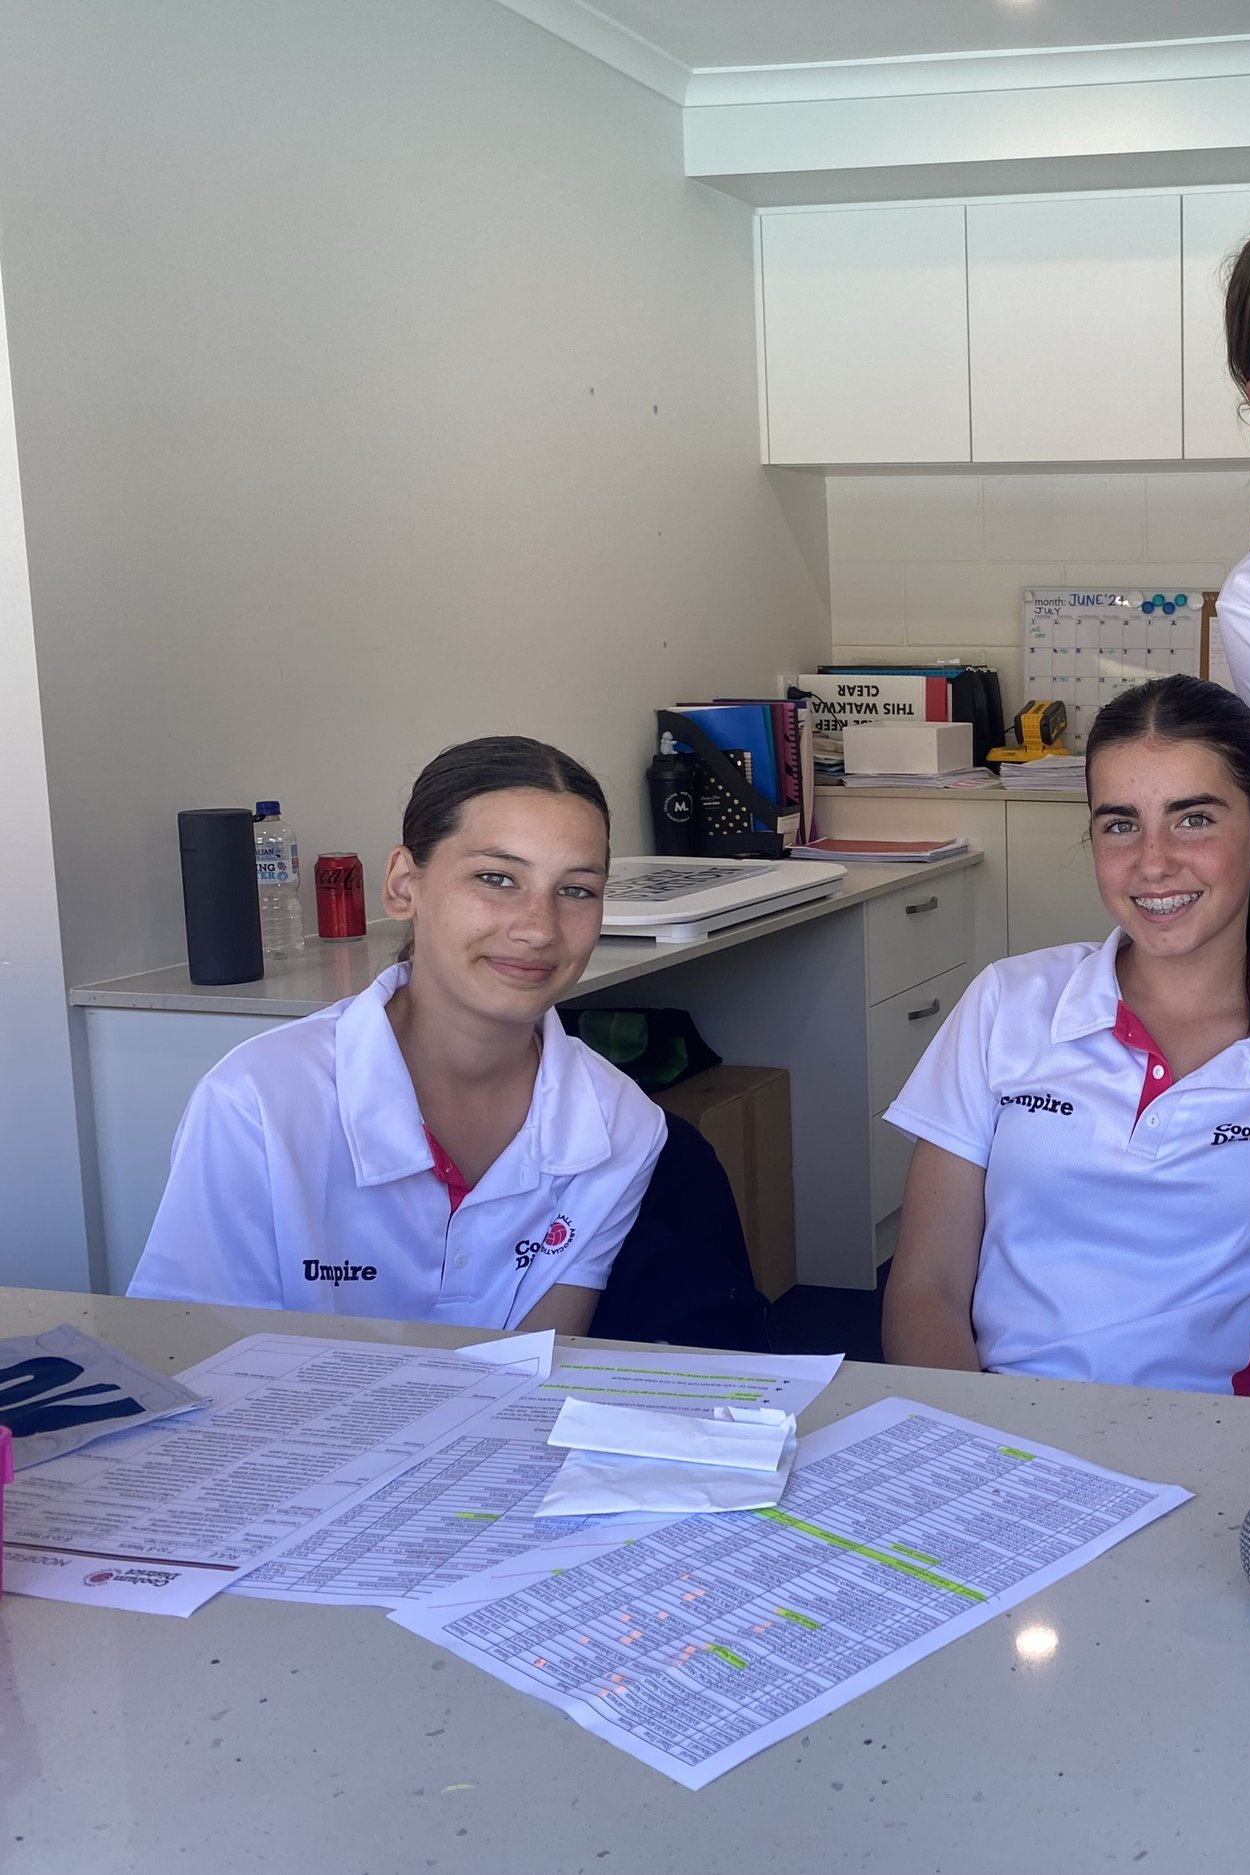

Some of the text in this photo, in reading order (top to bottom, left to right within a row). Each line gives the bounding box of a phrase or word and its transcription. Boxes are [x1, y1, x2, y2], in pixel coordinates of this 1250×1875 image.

[1034, 598, 1065, 607] month:
[837, 685, 879, 697] CLEAR
[809, 702, 914, 715] THIS WALKWA
[302, 1259, 378, 1287] Umpire
